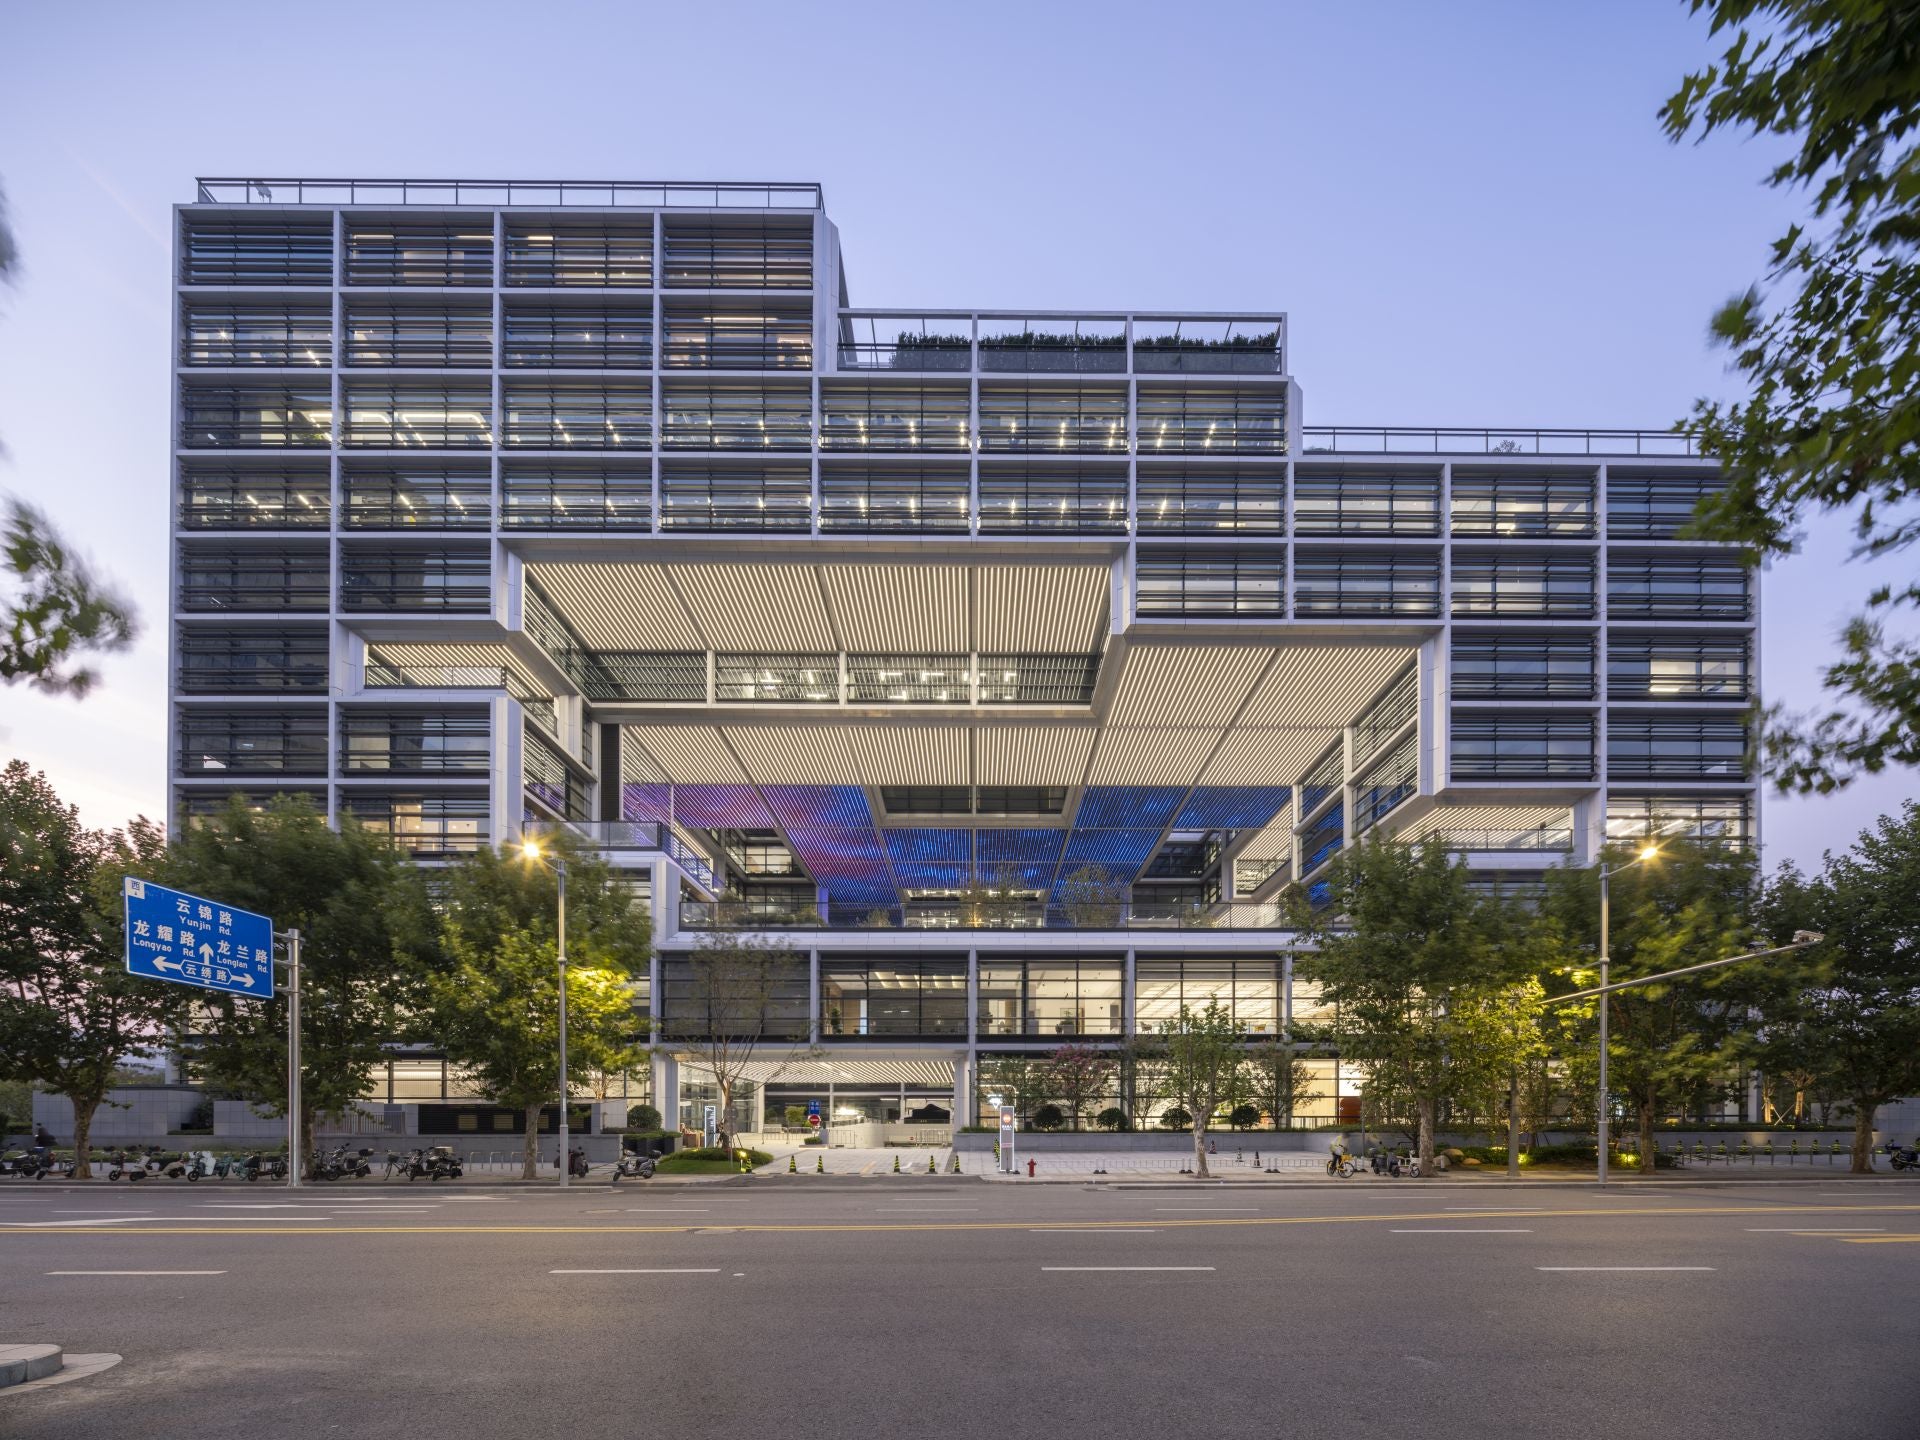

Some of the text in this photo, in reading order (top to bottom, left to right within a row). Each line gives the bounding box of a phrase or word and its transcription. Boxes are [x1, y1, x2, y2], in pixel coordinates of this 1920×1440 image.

[176, 898, 233, 927] 云锦路
[133, 919, 195, 947] 龙耀路
[179, 915, 232, 936] Yunjin Rd.
[133, 936, 196, 957] Longyao Rd.
[217, 940, 268, 964] 龙兰路
[185, 964, 227, 982] 云绣路
[216, 955, 268, 974] Longlan Rd.
